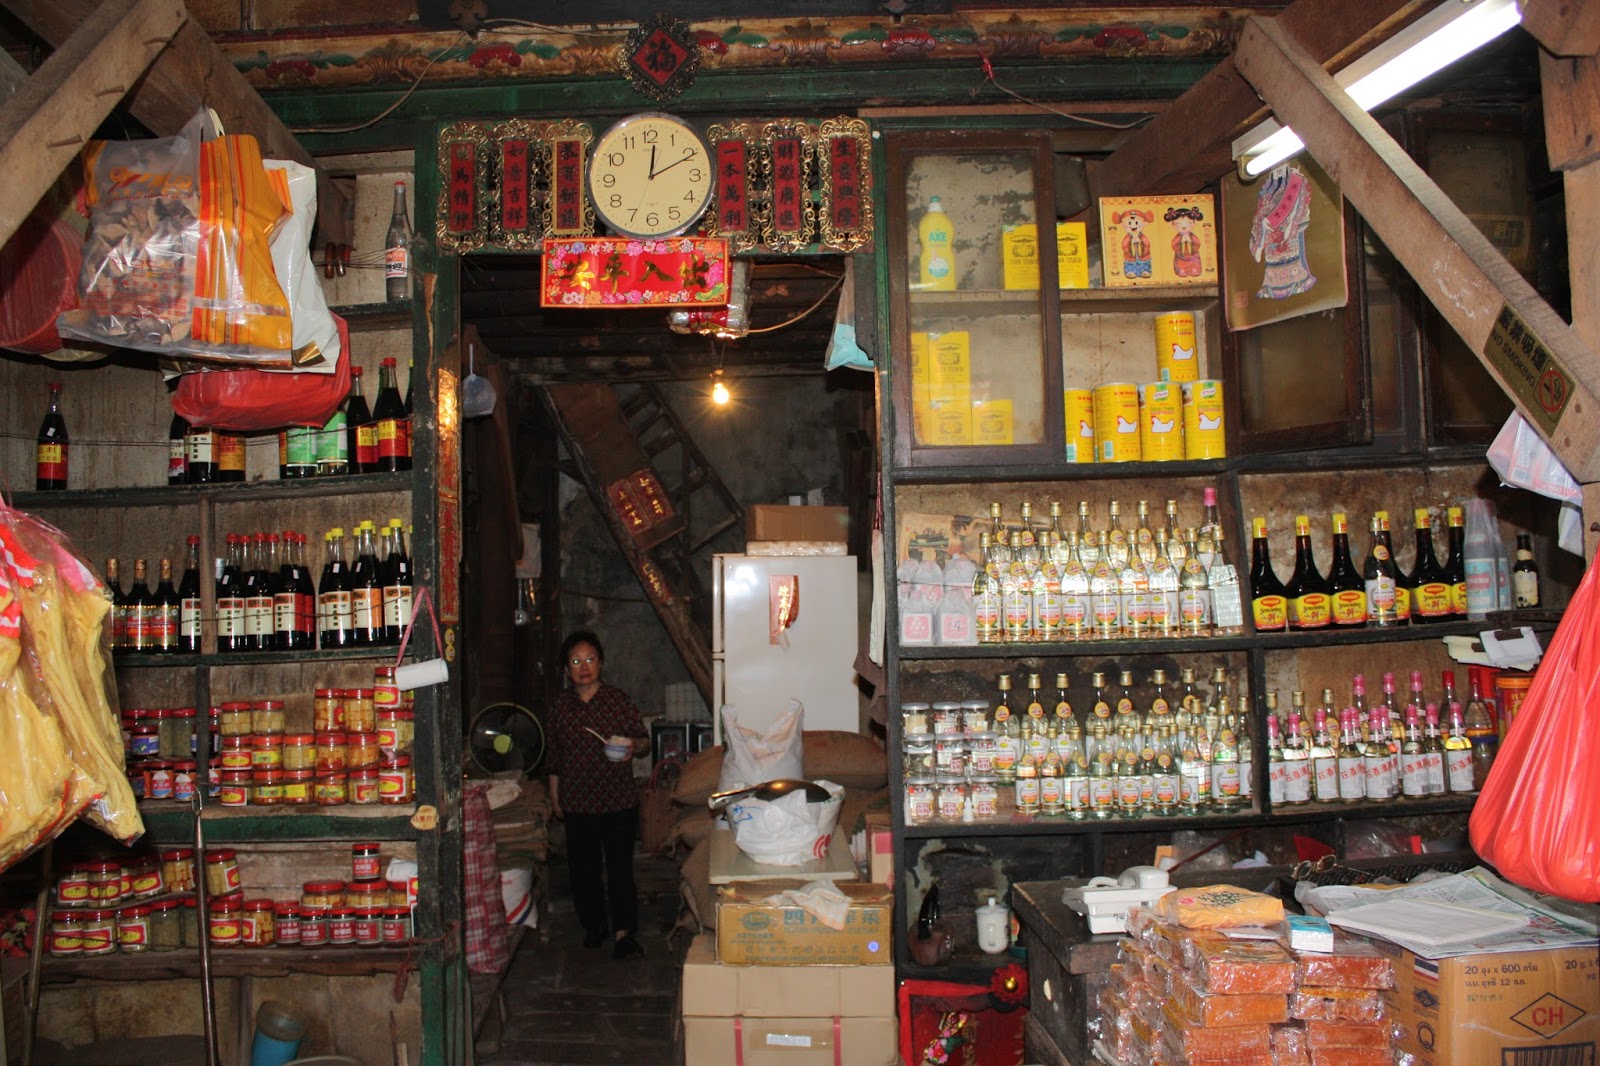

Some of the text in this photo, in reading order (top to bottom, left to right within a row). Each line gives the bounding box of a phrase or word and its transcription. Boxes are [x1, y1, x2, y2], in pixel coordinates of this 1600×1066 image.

[623, 136, 635, 150] 11
[642, 129, 658, 144] 12
[607, 152, 625, 167] 10
[682, 147, 695, 161] 2
[602, 173, 616, 188] 9
[688, 168, 701, 182] 3
[836, 139, 855, 225] 生意興隆
[506, 143, 524, 225] 如意吉祥
[722, 148, 741, 226] 一本萬利
[610, 193, 622, 208] 8
[683, 190, 696, 203] 4
[627, 208, 638, 222] 7
[646, 212, 659, 227] 6
[668, 206, 681, 220] 5
[928, 231, 947, 242] AXE
[1491, 329, 1536, 387] NO SMOKING
[1464, 965, 1479, 975] 20
[1501, 963, 1521, 973] 600
[1565, 959, 1577, 970] 20
[1500, 978, 1511, 986] 12
[1531, 1006, 1564, 1027] CH
